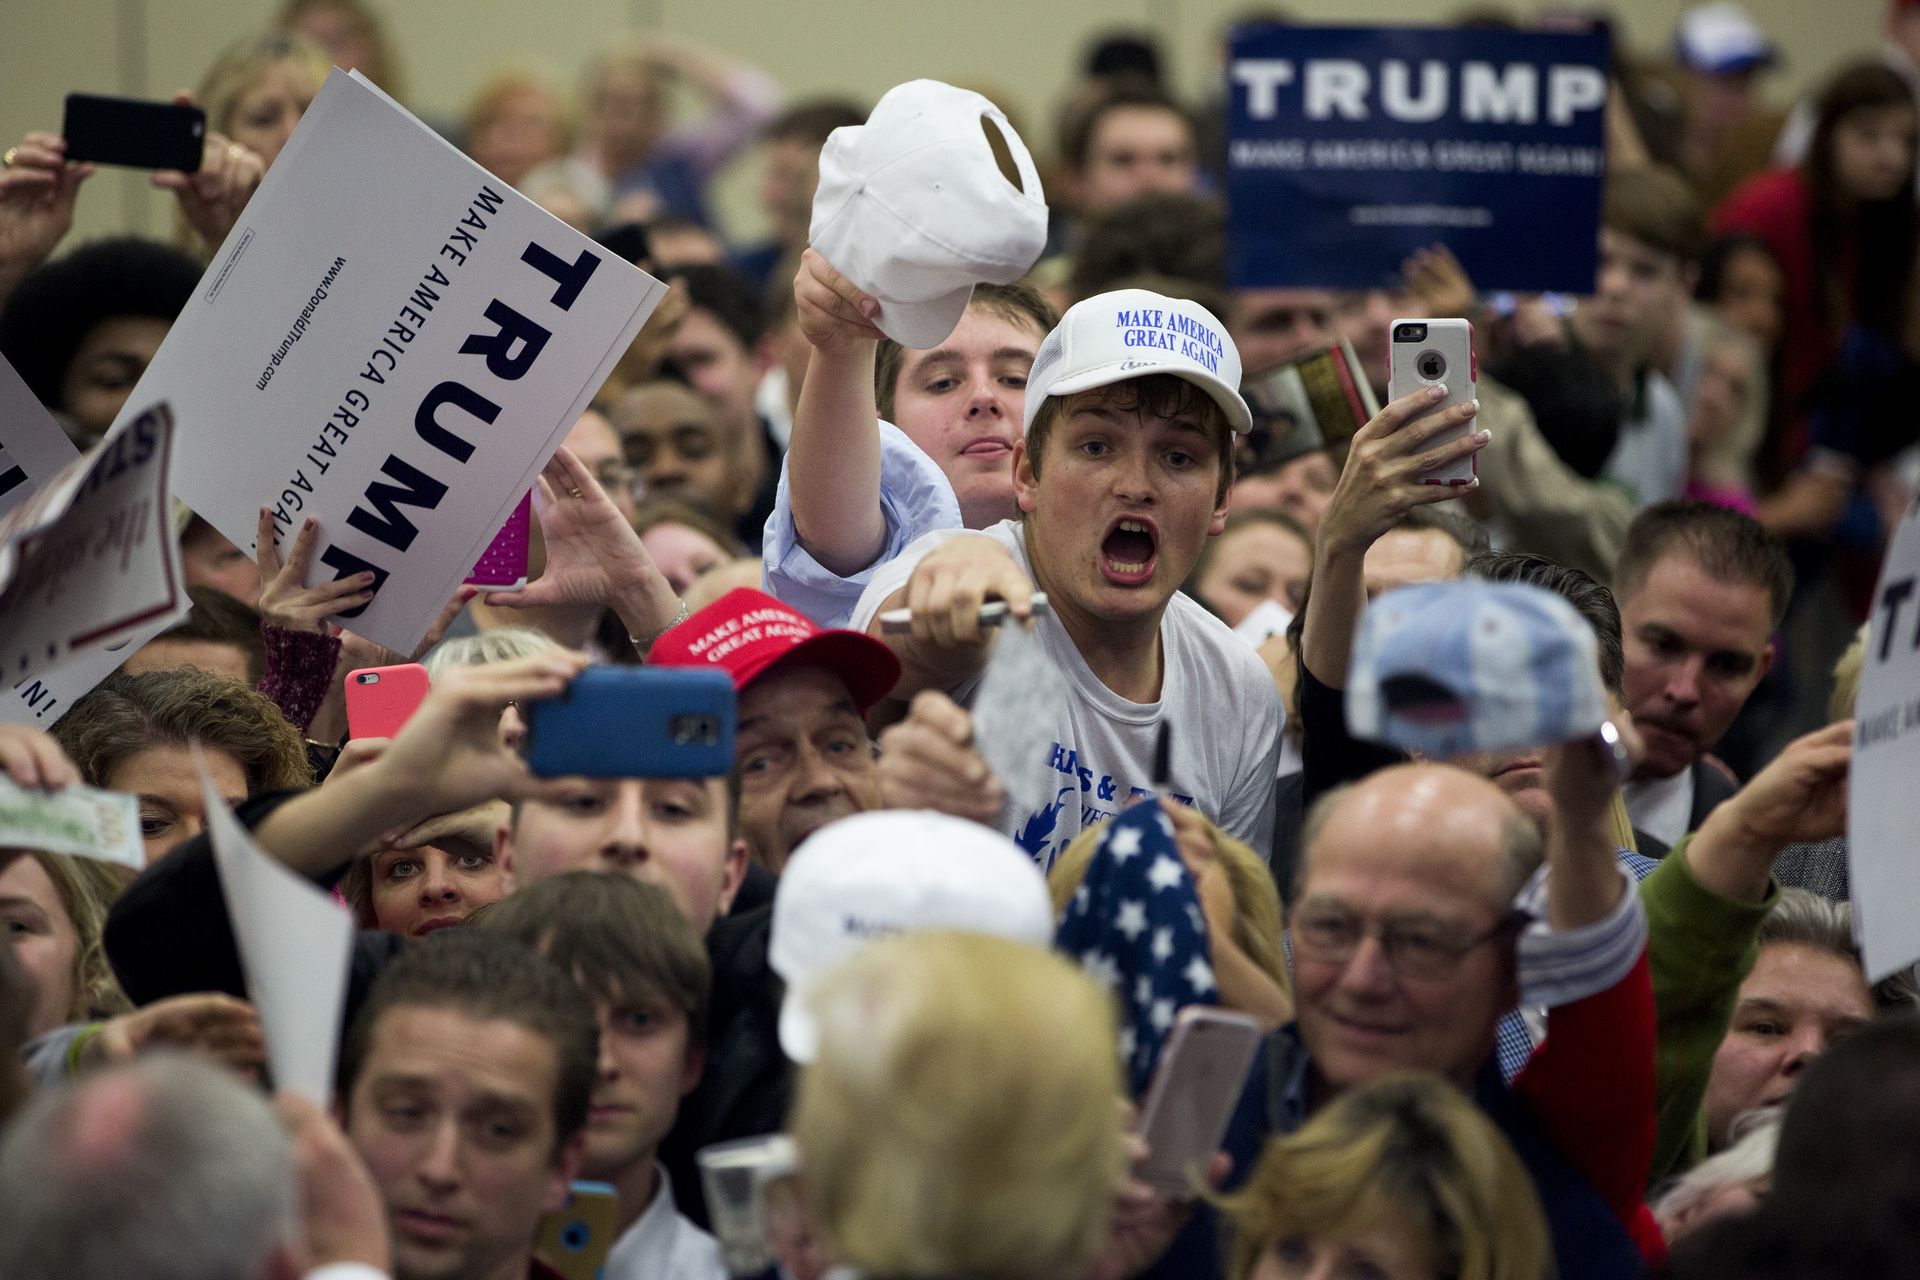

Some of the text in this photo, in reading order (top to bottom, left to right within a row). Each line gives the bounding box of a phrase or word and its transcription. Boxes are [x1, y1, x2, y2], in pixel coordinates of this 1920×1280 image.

[1231, 58, 1607, 127] TRUMP
[439, 185, 505, 267] MAKE
[255, 256, 347, 391] www.DonaldJTrump.com
[359, 263, 450, 385] AMERICA
[1116, 309, 1224, 359] MAKE AMERICA
[1124, 329, 1176, 351] GREAT
[1180, 338, 1218, 376] AGAIN
[306, 389, 370, 476] GREAT
[687, 618, 743, 657] MAKE
[706, 626, 763, 663] GREAT
[1097, 775, 1116, 801] &
